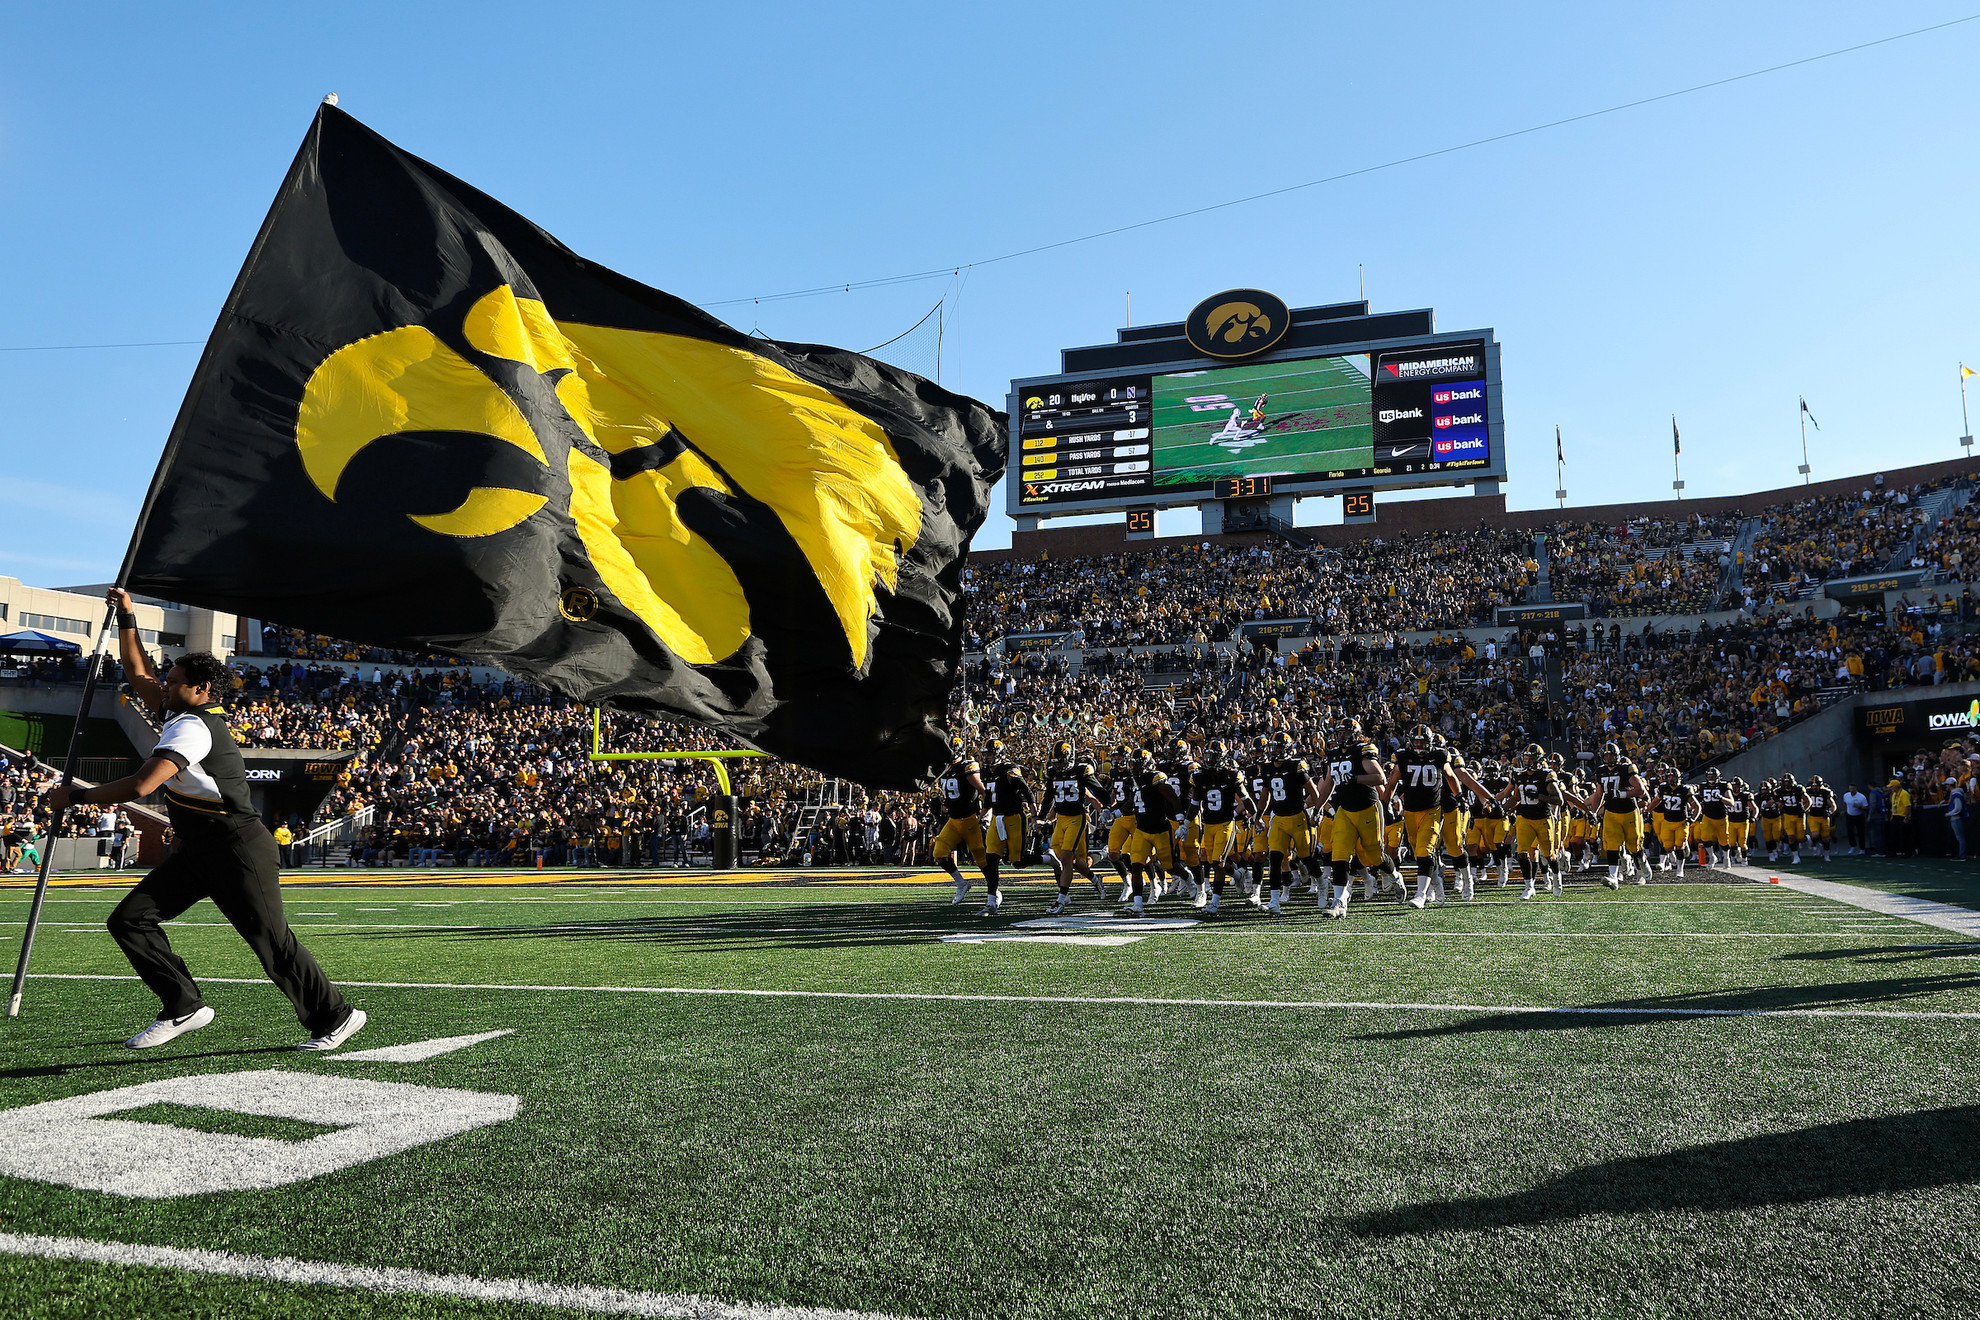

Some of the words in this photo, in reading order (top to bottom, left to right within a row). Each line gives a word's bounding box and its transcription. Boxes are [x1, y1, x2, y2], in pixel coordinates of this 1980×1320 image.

[1398, 356, 1474, 371] MIDAMERICAN
[1398, 367, 1431, 378] ENERGY
[1049, 394, 1060, 405] 20
[1110, 388, 1117, 399] 0
[1128, 411, 1136, 423] 3
[1045, 420, 1054, 429] &
[1068, 435, 1084, 444] RUSH
[1084, 433, 1101, 442] YARDS
[1069, 452, 1084, 460] PASS
[1083, 450, 1101, 459] YARDS
[1128, 447, 1136, 455] 57
[1068, 467, 1084, 476] TOTAL
[1084, 466, 1102, 475] YARDS
[1405, 464, 1413, 472] 21
[1040, 480, 1105, 494] XTREAM
[1230, 478, 1267, 496] 3:31
[1347, 495, 1369, 513] 25
[1130, 512, 1150, 529] 25
[1520, 612, 1536, 620] 217
[1544, 611, 1560, 619] 218
[1280, 625, 1294, 633] 217
[1020, 639, 1033, 647] 215
[1866, 708, 1904, 726] IOWA
[1928, 712, 1971, 728] IOWA
[305, 763, 342, 775] IOWA
[1406, 764, 1438, 787] 70
[940, 778, 961, 800] 79
[986, 781, 997, 803] 7
[1053, 780, 1080, 803] 33
[1113, 781, 1125, 801] 3
[1270, 777, 1287, 801] 8
[1600, 776, 1621, 798] 77
[1133, 790, 1146, 813] 4
[1206, 789, 1222, 812] 9
[1662, 794, 1682, 811] 32
[1782, 795, 1797, 807] 31
